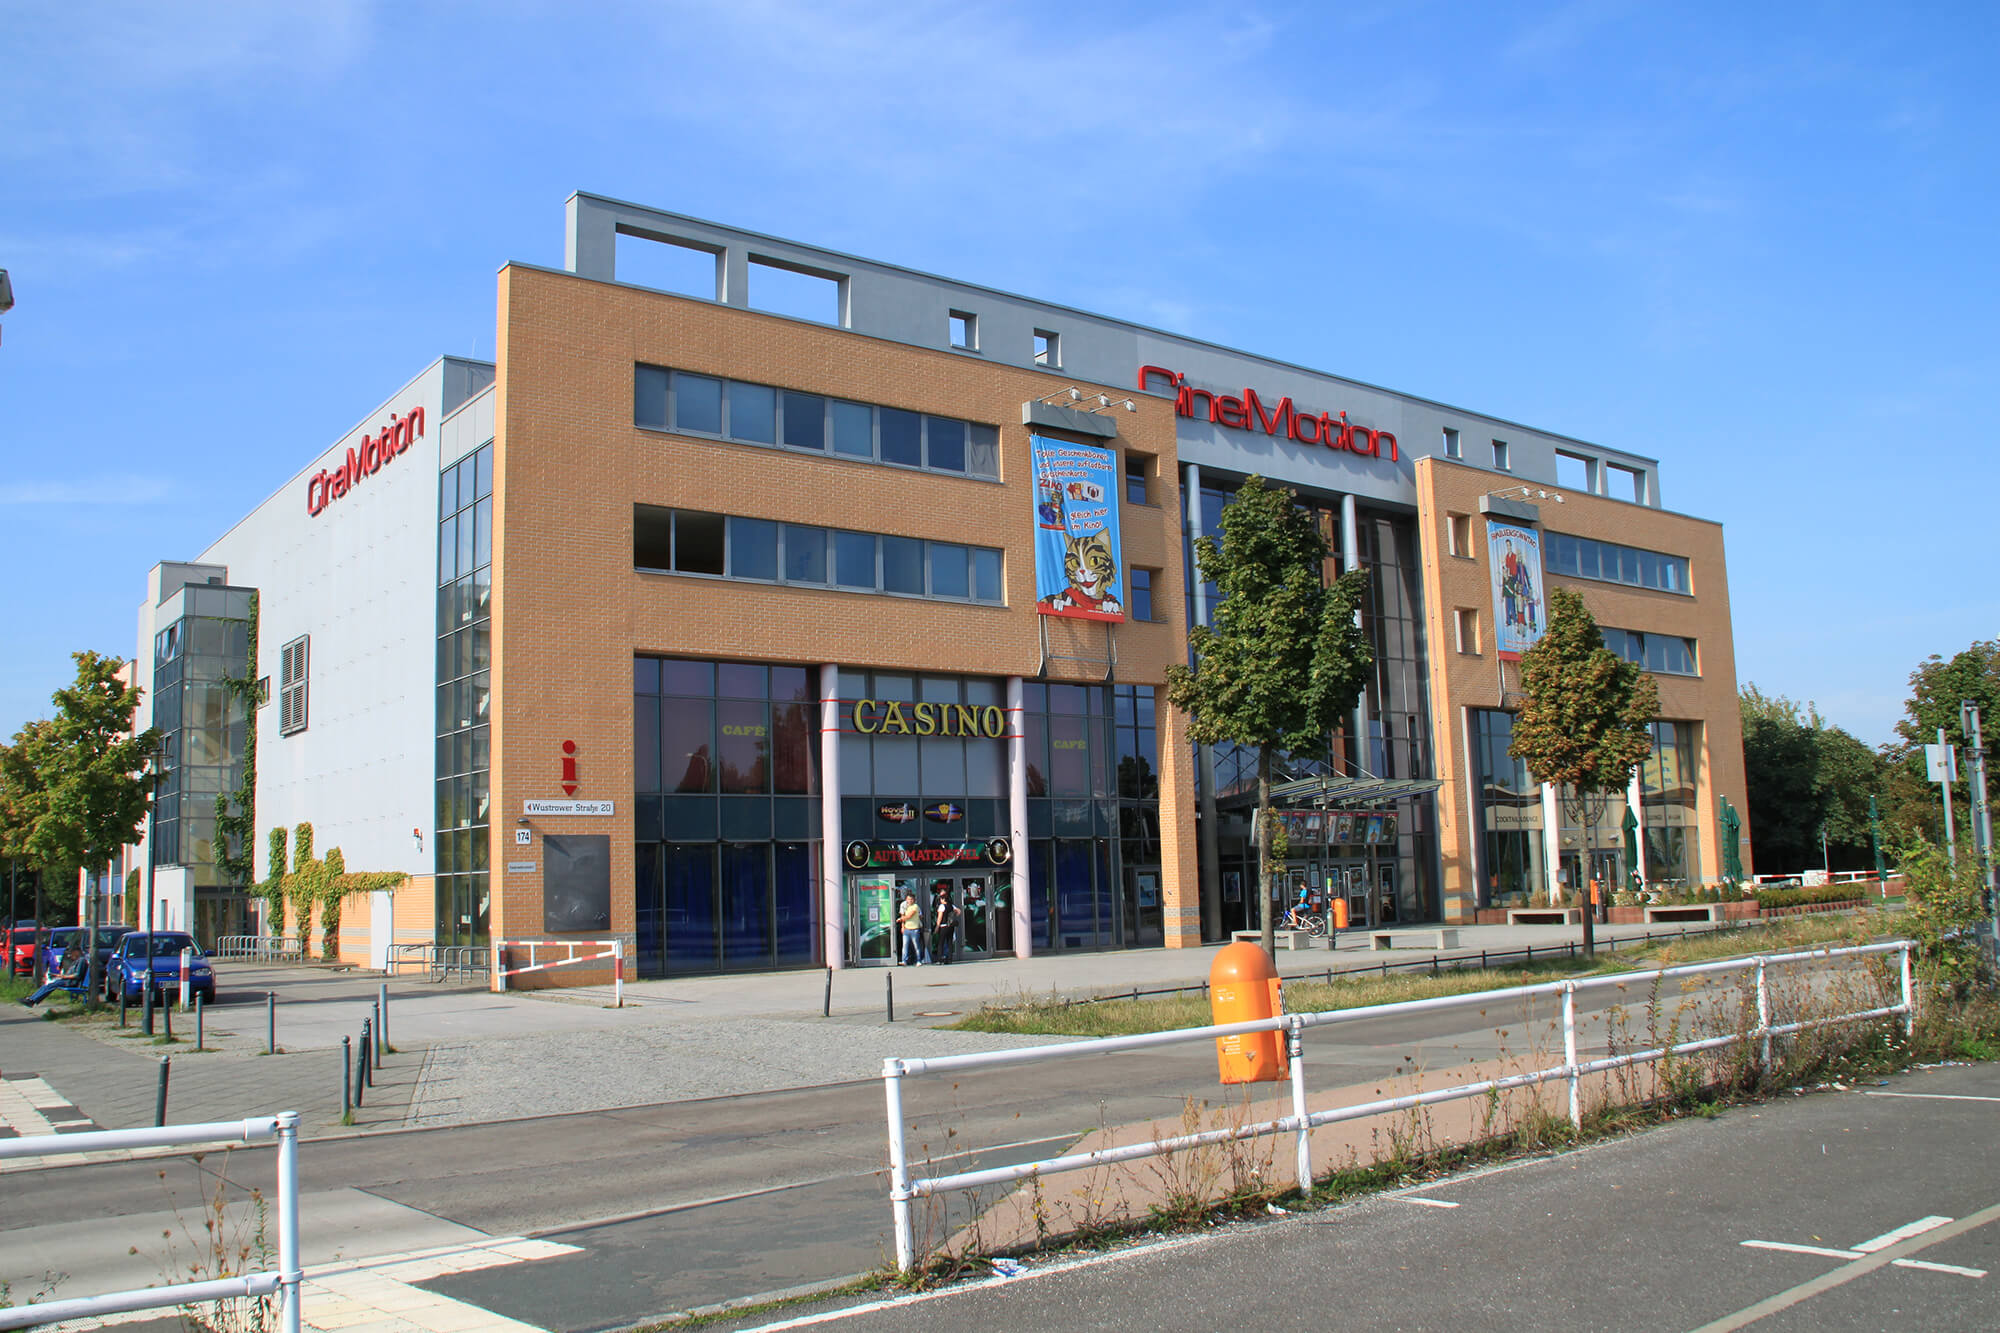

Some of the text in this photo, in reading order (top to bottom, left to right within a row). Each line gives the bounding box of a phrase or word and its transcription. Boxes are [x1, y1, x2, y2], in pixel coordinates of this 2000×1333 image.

[307, 406, 425, 517] CineMotion
[1053, 460, 1074, 468] unsere
[1078, 461, 1112, 471] aufladbare
[1071, 508, 1108, 520] gleich hier
[852, 698, 1005, 738] CASINO
[532, 803, 611, 814] Wustrower Straße 20
[517, 832, 530, 841] 174
[873, 849, 980, 863] AUTOMATENSPIEL
